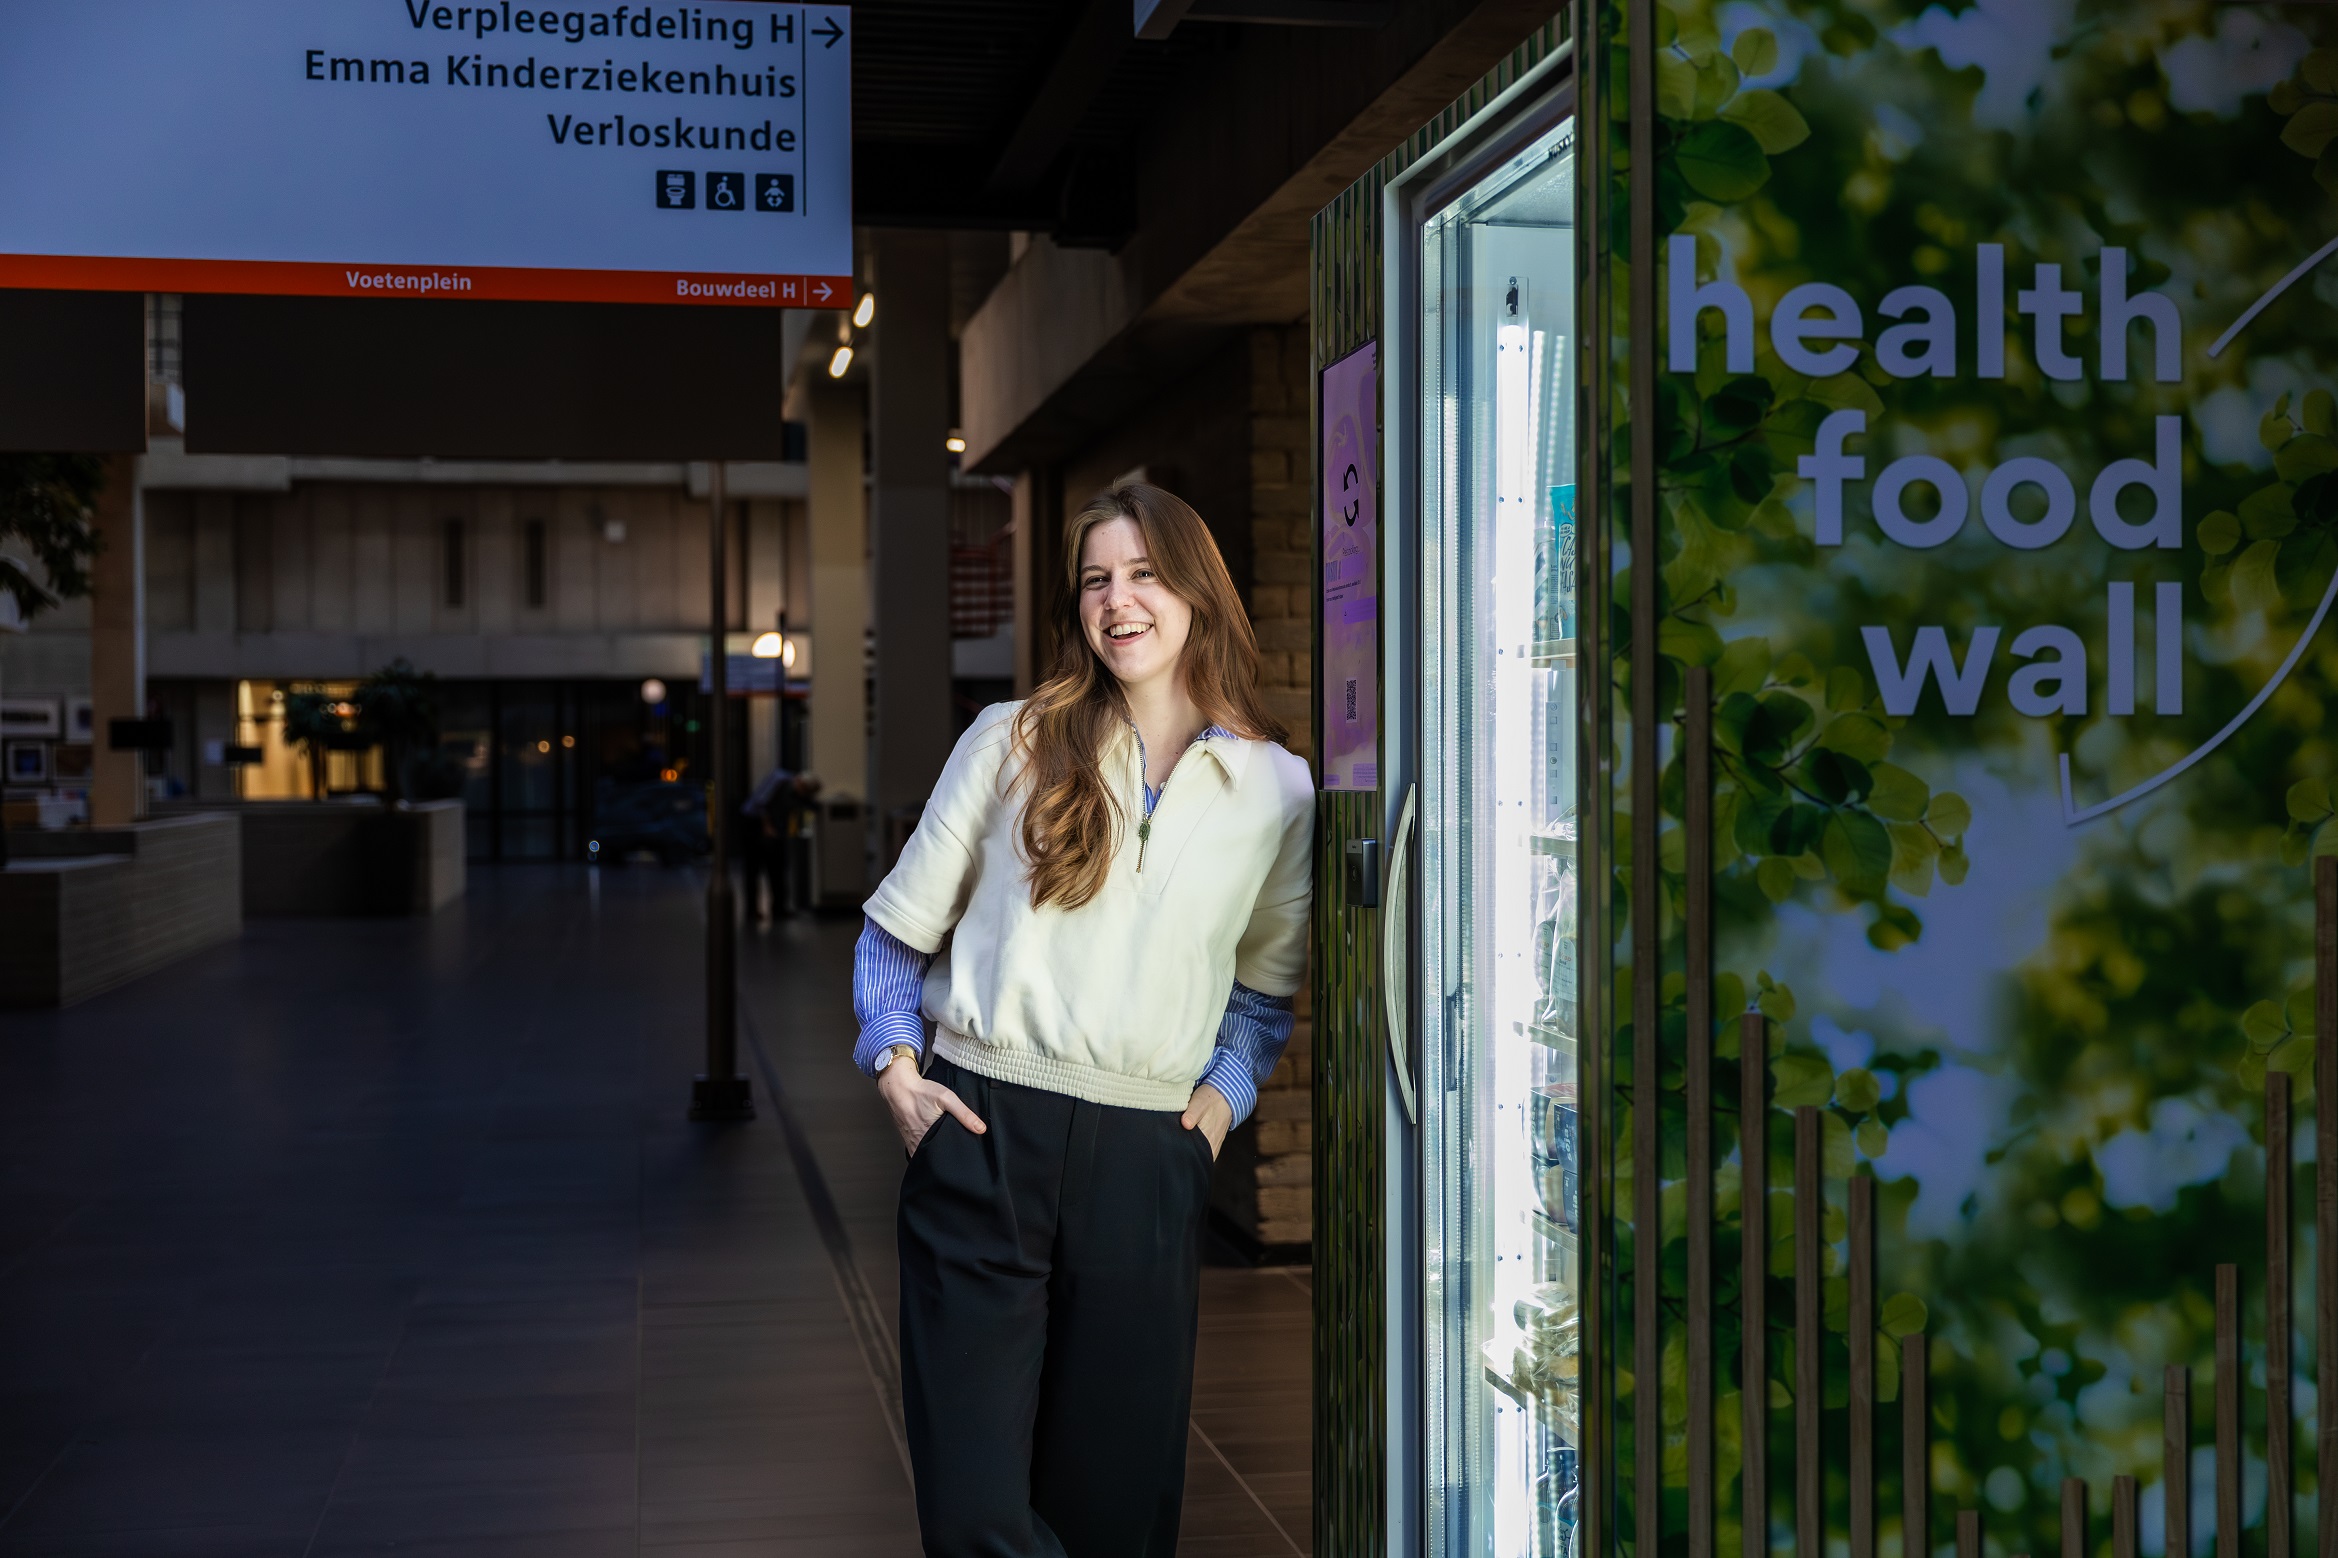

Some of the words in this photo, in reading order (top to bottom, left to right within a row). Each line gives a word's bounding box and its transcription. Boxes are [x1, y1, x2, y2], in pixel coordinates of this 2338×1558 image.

[404, 0, 754, 50] Verpleegafdeling
[769, 13, 795, 44] H
[306, 50, 430, 85] Emma
[447, 54, 796, 99] Kinderziekenhuis
[547, 113, 796, 152] Verloskunde
[345, 270, 472, 294] Voetenplein
[676, 278, 776, 299] Bouwdeel
[782, 283, 797, 299] H
[1667, 234, 2183, 383] health
[1797, 408, 2183, 550] food
[1860, 581, 2184, 717] wall
